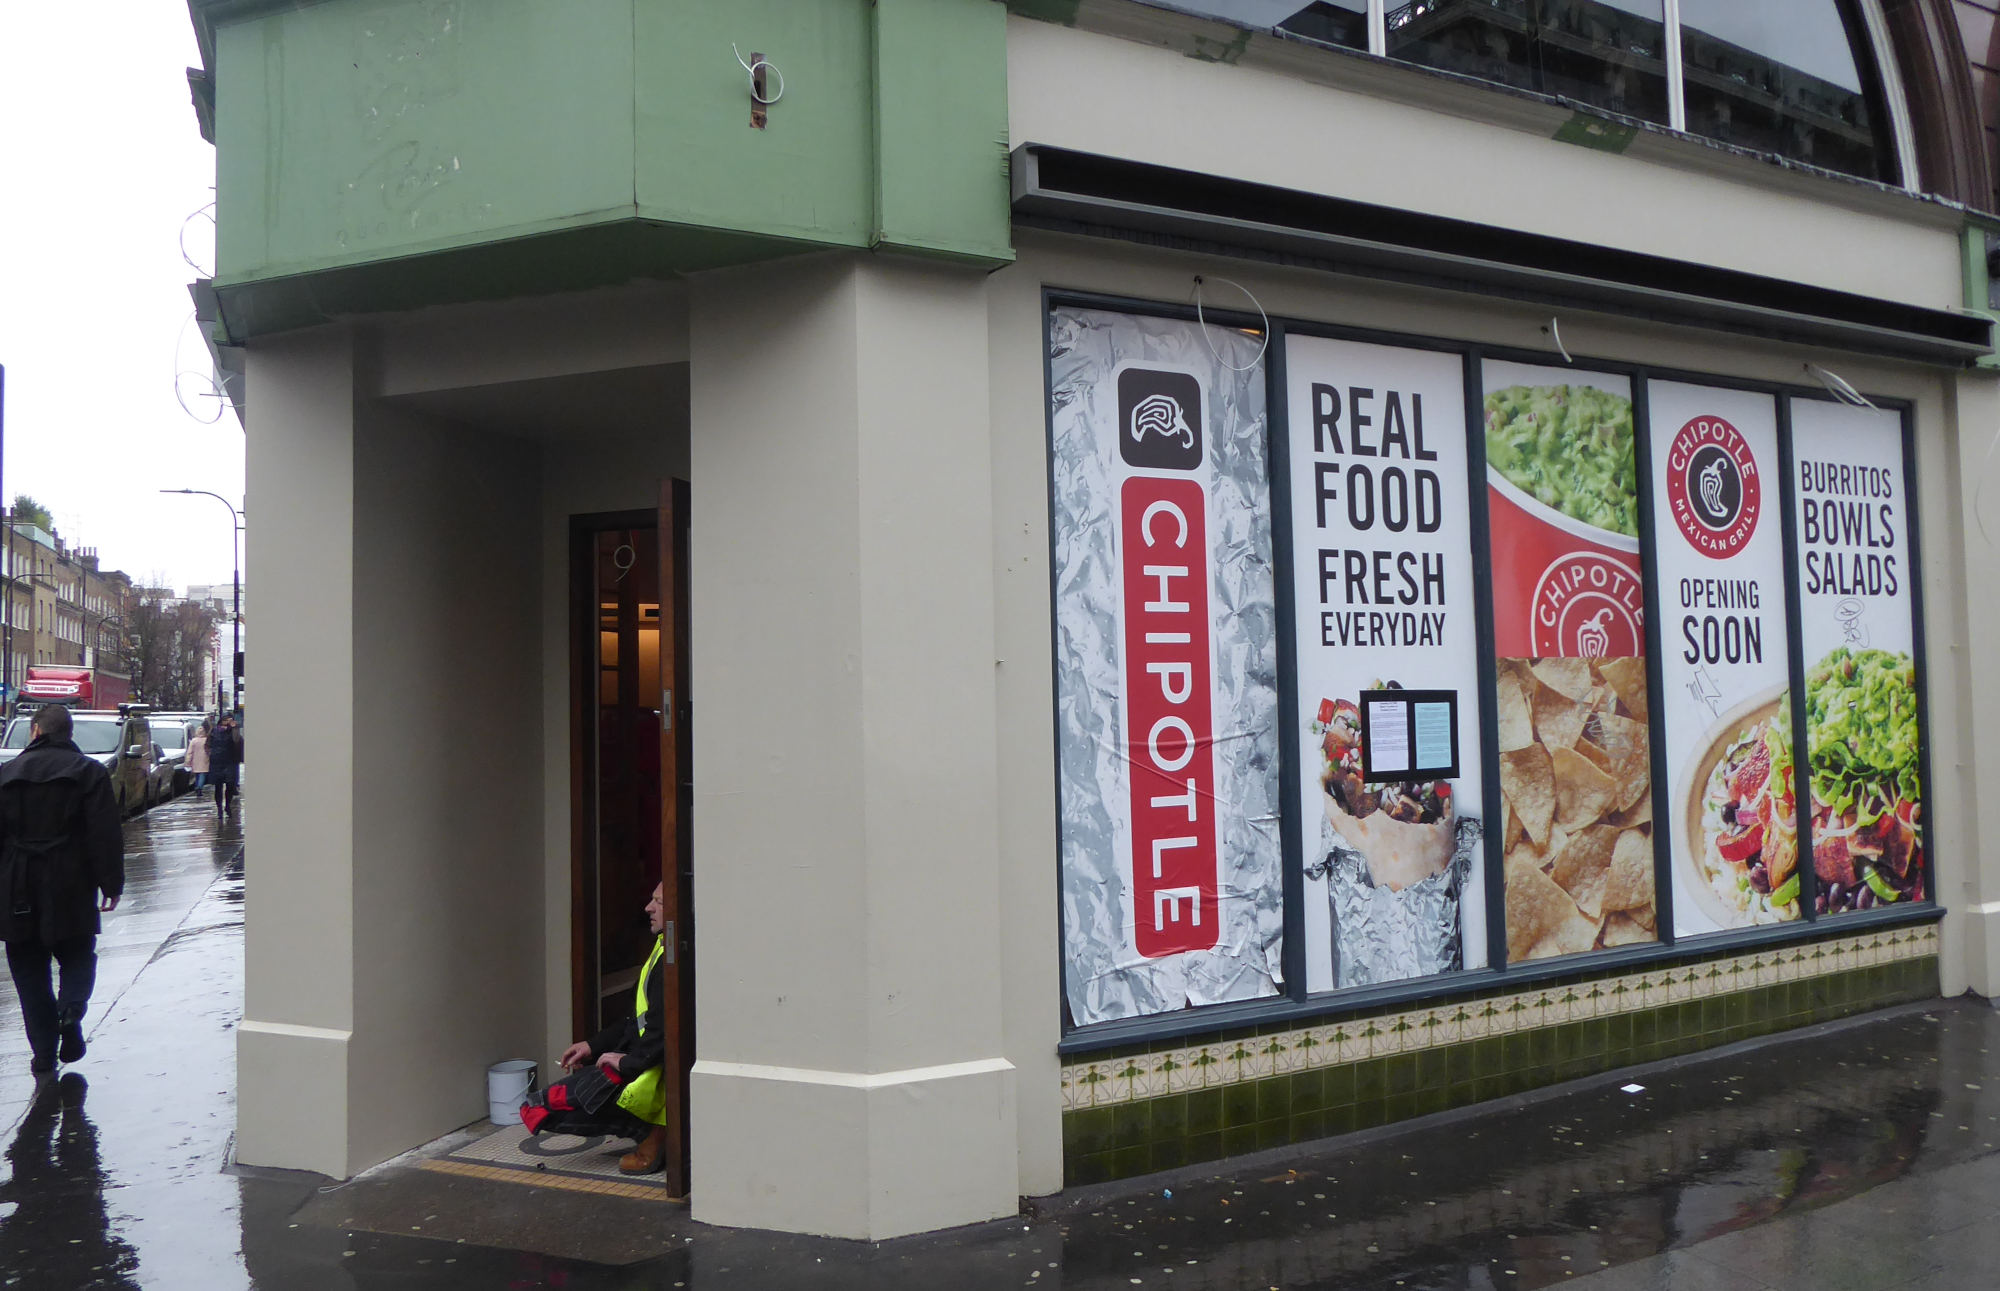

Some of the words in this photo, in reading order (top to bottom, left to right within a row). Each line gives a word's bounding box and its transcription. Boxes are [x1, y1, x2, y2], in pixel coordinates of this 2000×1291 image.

[1311, 383, 1437, 461] REAL
[1672, 422, 1754, 478] CHIPOTLE
[1315, 461, 1442, 533] FOOD
[1801, 461, 1892, 498] BURRITOS
[1676, 498, 1727, 550] MEXICAN
[1729, 504, 1755, 546] GRILL
[1803, 499, 1895, 548] BOWLS
[1319, 549, 1446, 605] FRESH
[1680, 578, 1760, 609] OPENING
[1806, 551, 1898, 597] SALADS
[1321, 612, 1446, 647] EVERYDAY
[1682, 615, 1762, 664] SOON
[1142, 500, 1201, 931] CHIPOTLE
